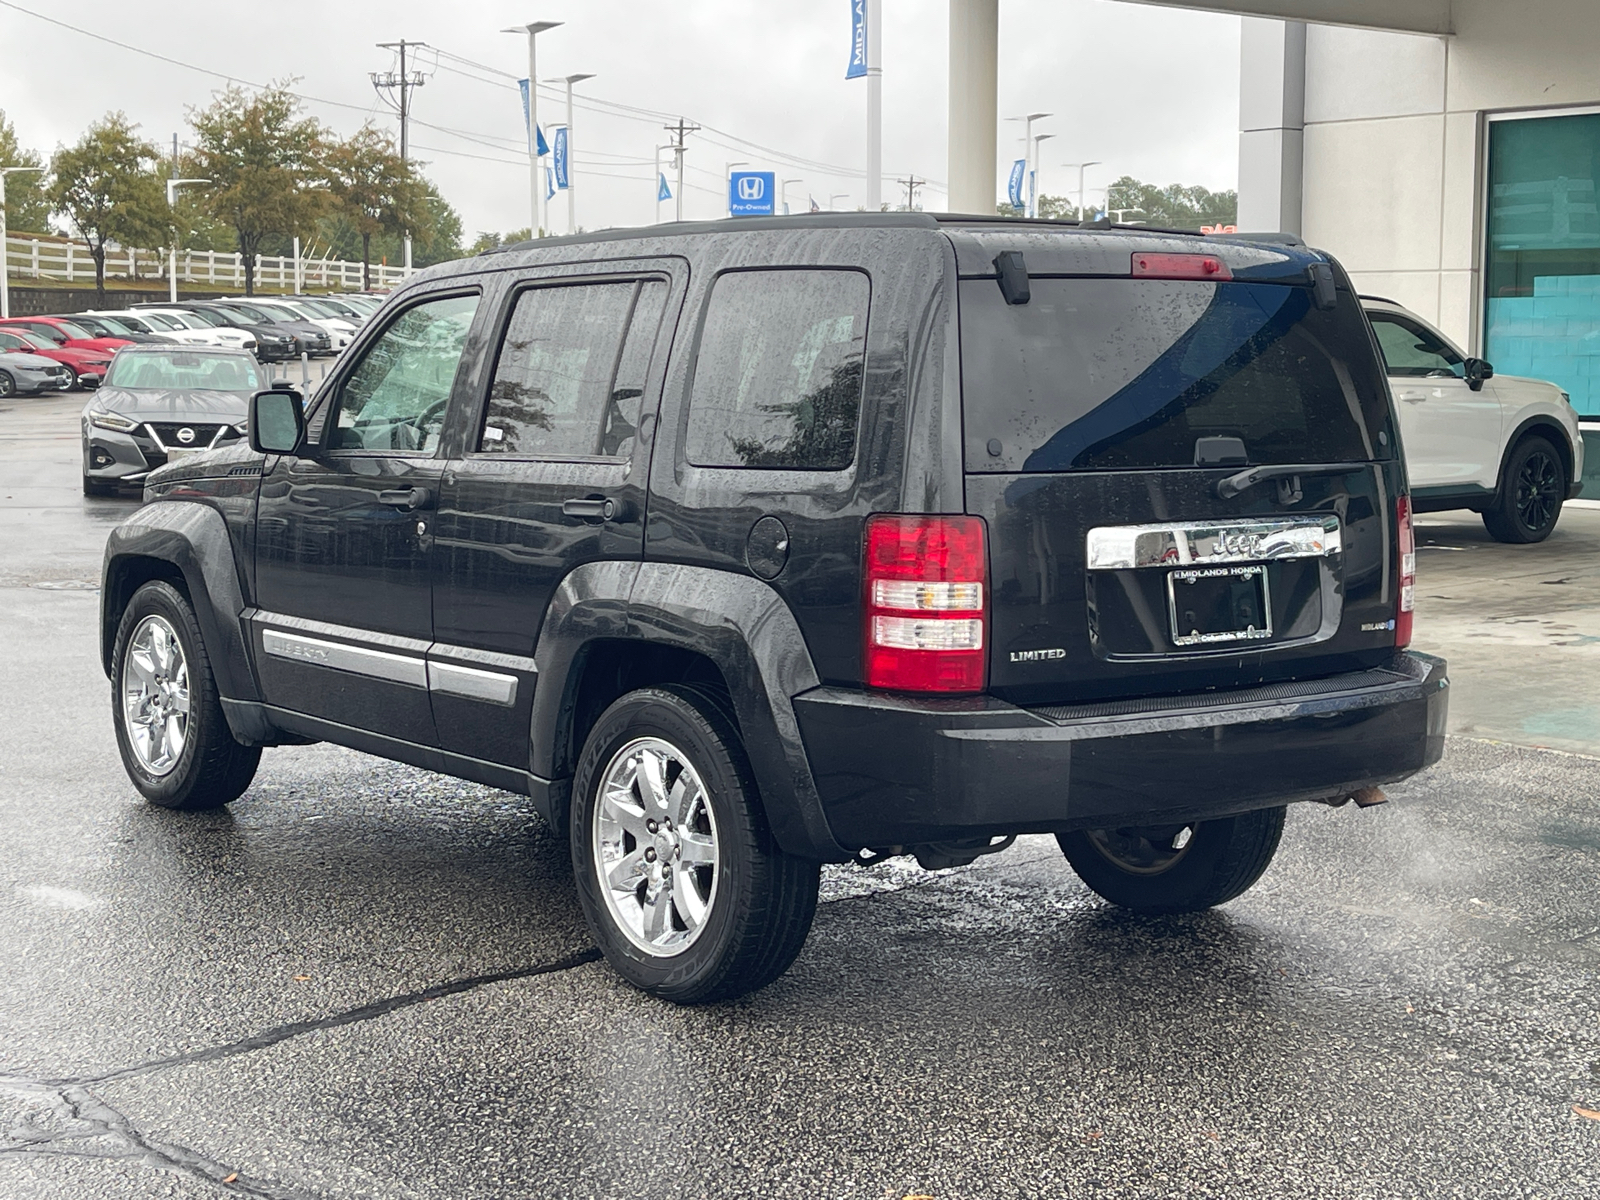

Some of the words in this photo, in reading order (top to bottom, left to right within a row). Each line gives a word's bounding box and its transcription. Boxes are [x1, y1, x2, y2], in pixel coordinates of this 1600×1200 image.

[853, 0, 864, 66] MIDLA
[732, 203, 771, 211] Pre-Owned
[1212, 529, 1261, 557] Jeep
[1181, 568, 1228, 578] MIDLANDS
[1230, 566, 1262, 575] HONDA
[1010, 649, 1067, 662] LIMITED
